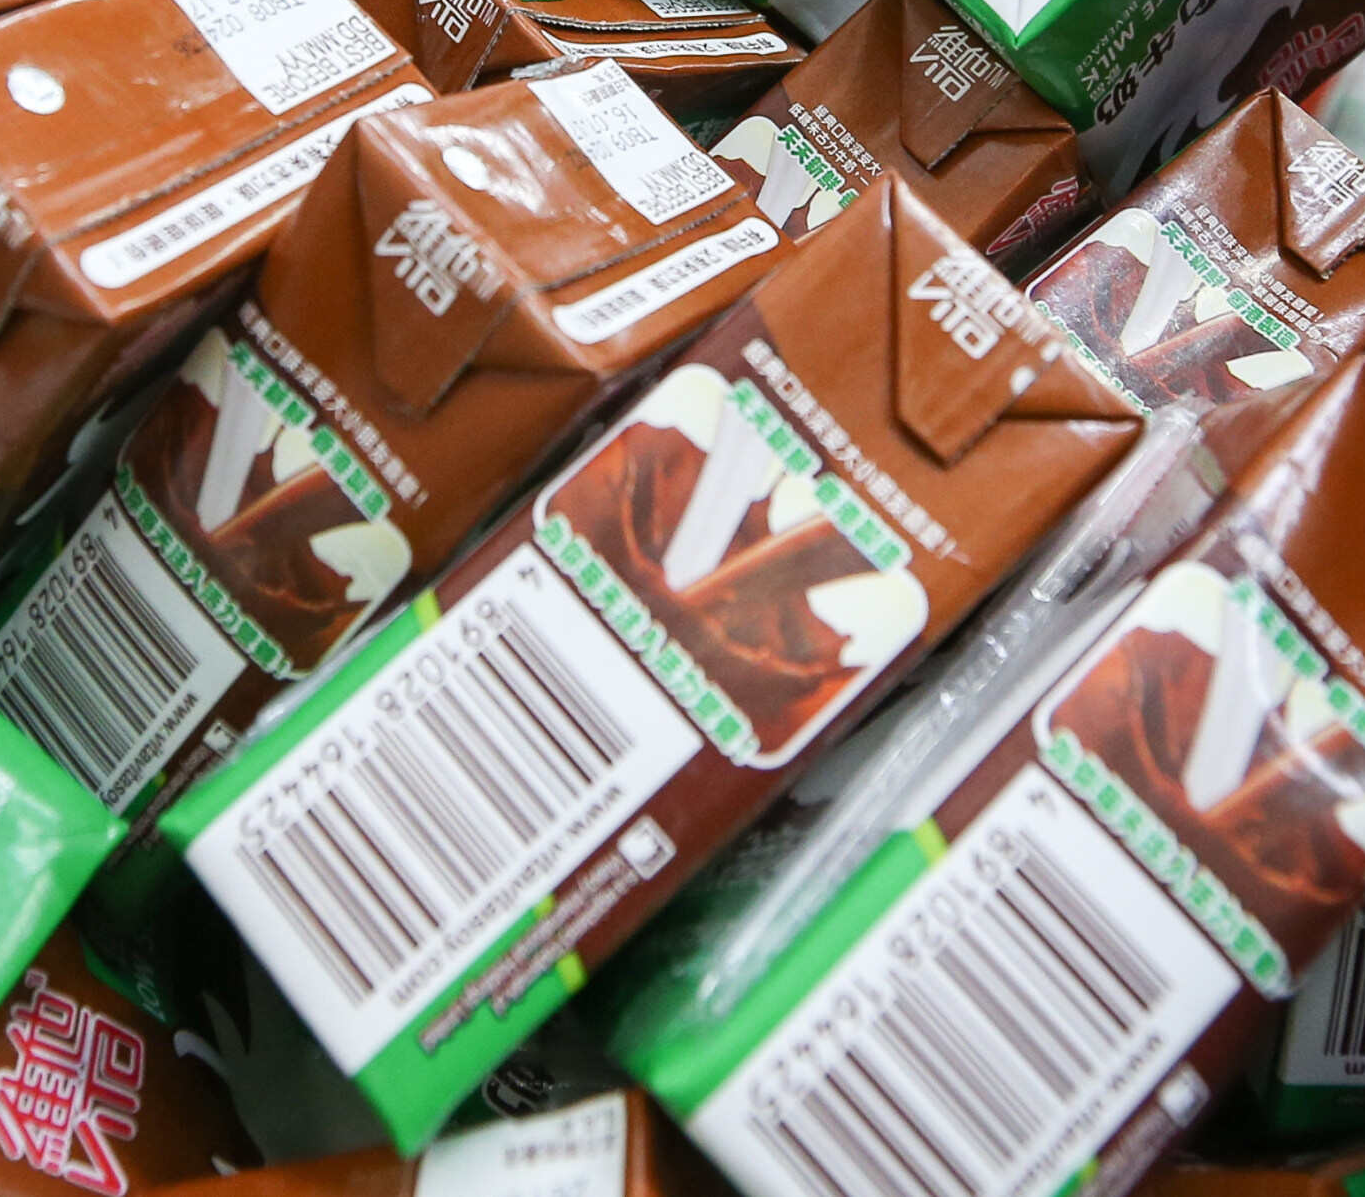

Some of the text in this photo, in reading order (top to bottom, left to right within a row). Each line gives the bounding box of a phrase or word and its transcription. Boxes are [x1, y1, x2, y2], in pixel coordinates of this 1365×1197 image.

[262, 27, 385, 108] BEST BEFORE
[1081, 21, 1137, 92] MILK
[686, 162, 725, 199] BEST
[776, 125, 845, 191] 天天新鮮
[1159, 219, 1301, 353] 天天新鮮 香港製造
[102, 505, 122, 533] 4
[26, 531, 100, 631] 891028
[516, 564, 543, 591] 4
[373, 597, 502, 724] 891028
[234, 716, 369, 856] 164425
